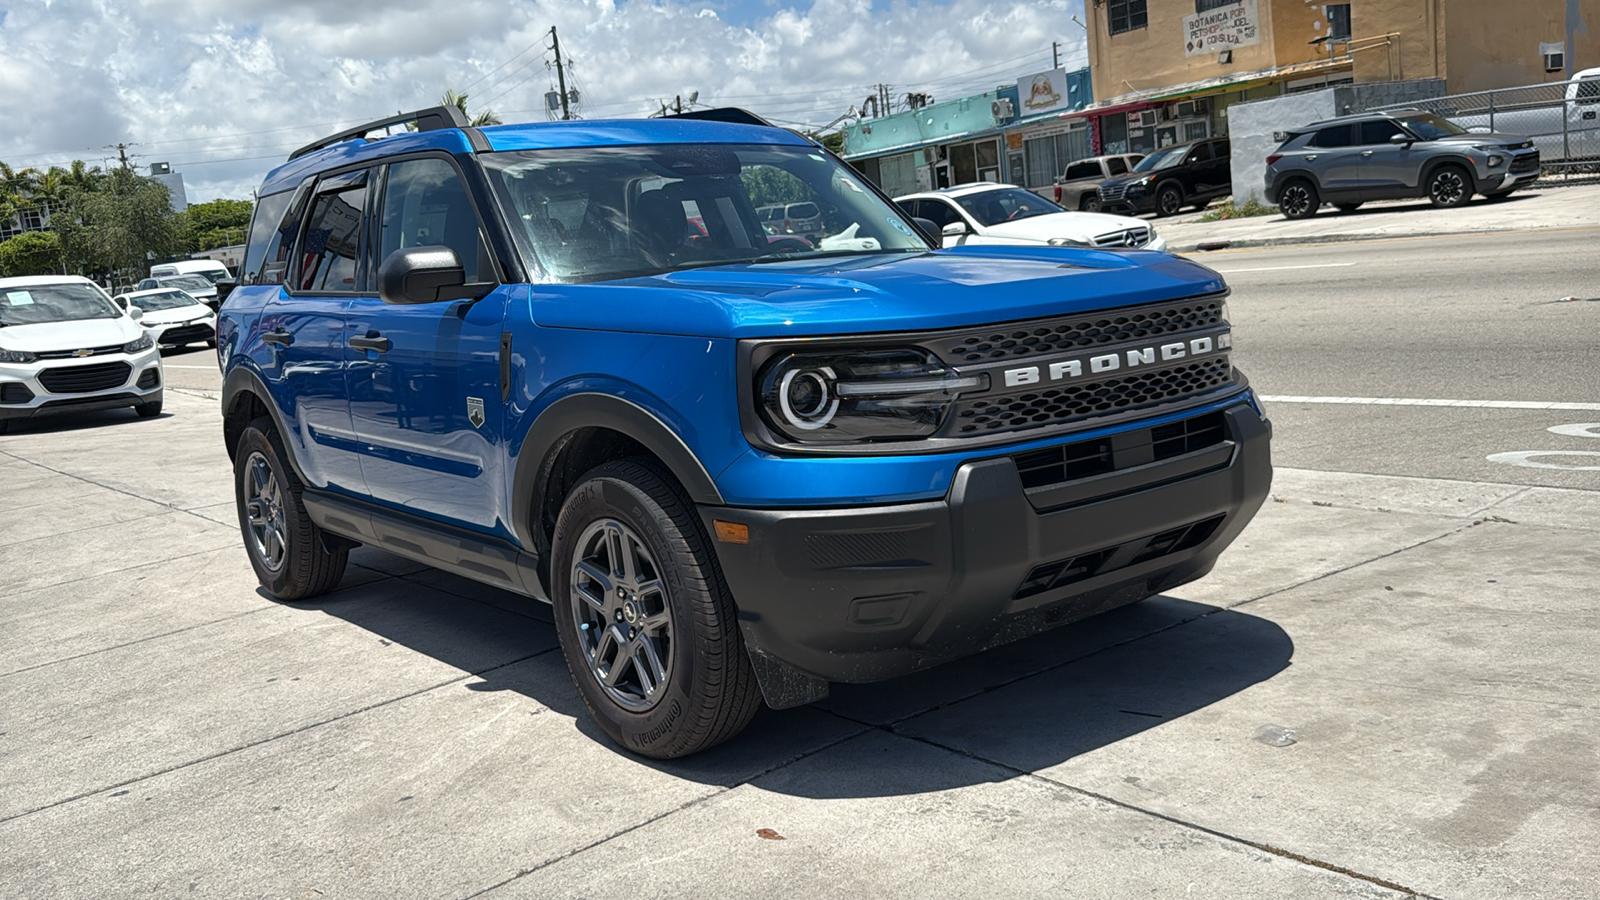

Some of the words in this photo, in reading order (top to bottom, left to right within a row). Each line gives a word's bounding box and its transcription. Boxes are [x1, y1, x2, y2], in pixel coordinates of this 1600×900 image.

[1189, 12, 1228, 30] BOTANICA
[1232, 17, 1249, 28] JOEL
[1207, 33, 1240, 45] CONSULTA
[1004, 337, 1213, 388] BRONCO
[557, 486, 589, 541] Continental
[638, 698, 682, 748] Continental
